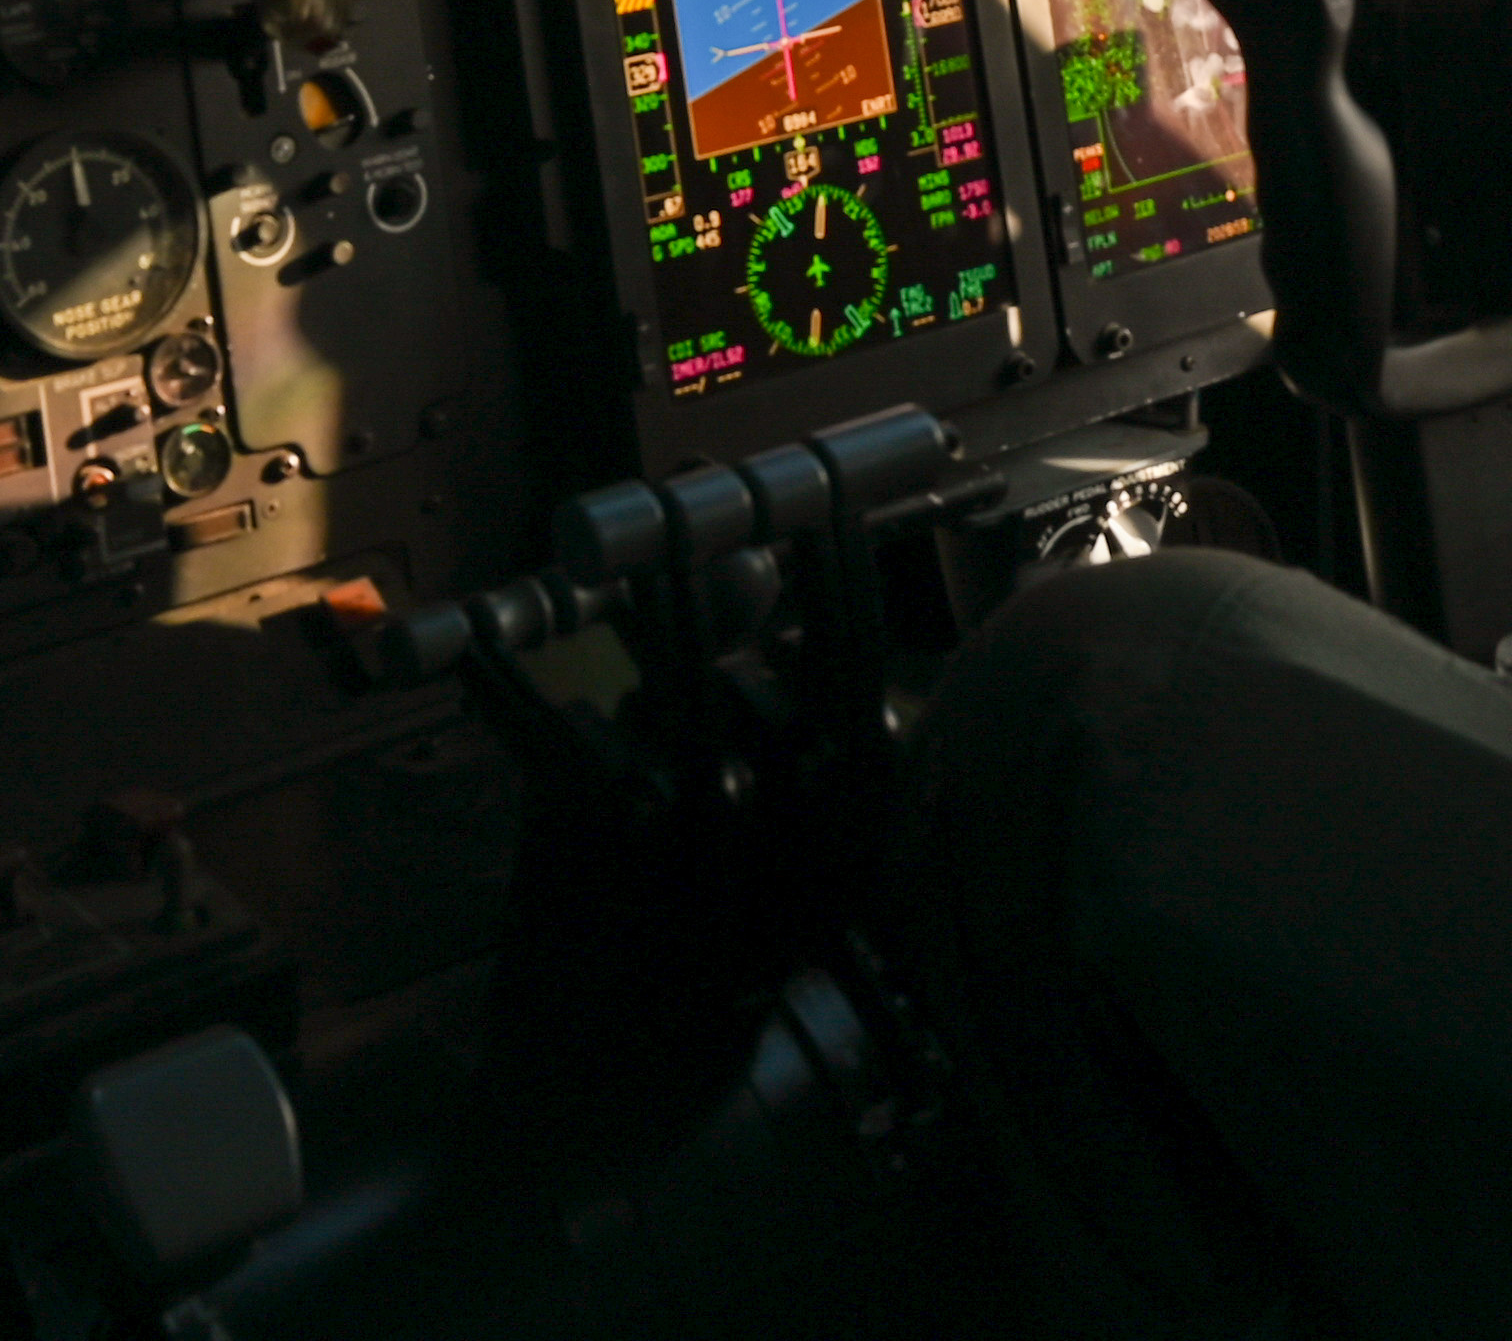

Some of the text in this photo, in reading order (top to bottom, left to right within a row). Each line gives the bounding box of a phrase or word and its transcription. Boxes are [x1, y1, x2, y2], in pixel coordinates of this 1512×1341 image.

[714, 3, 733, 24] 10
[839, 65, 858, 85] 10
[52, 288, 143, 327] NOSE GEAR
[64, 310, 136, 340] POSITION
